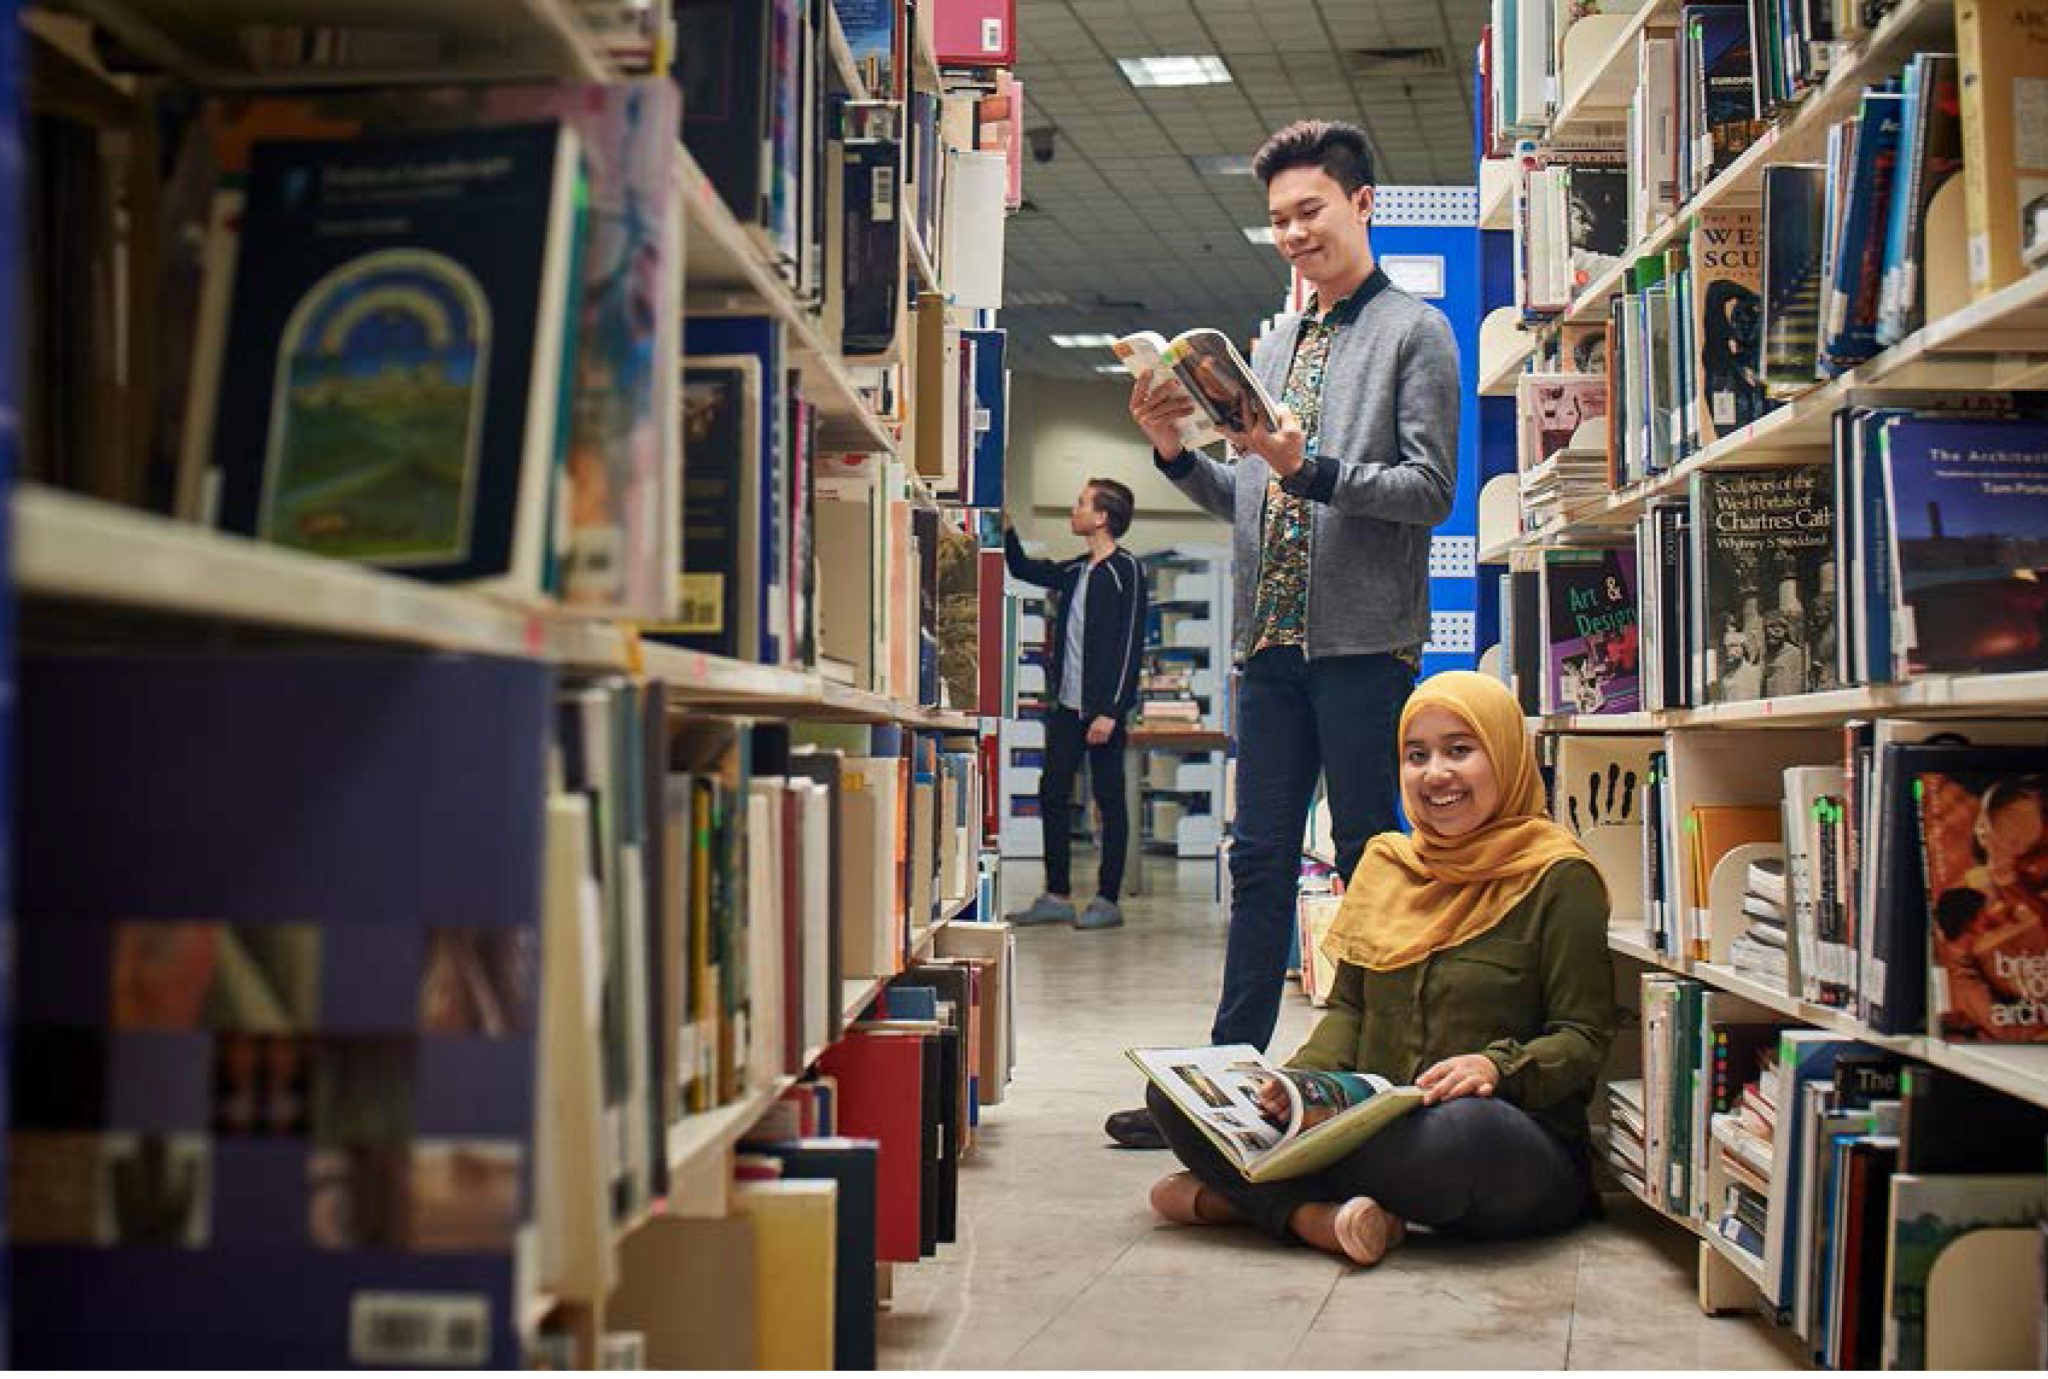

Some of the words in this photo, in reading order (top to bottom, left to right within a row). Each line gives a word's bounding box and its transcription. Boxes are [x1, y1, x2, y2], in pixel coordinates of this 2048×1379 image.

[1929, 448, 1961, 461] The
[1716, 510, 1795, 531] Chartres
[1570, 586, 1599, 612] Art
[1856, 1068, 1896, 1092] The
